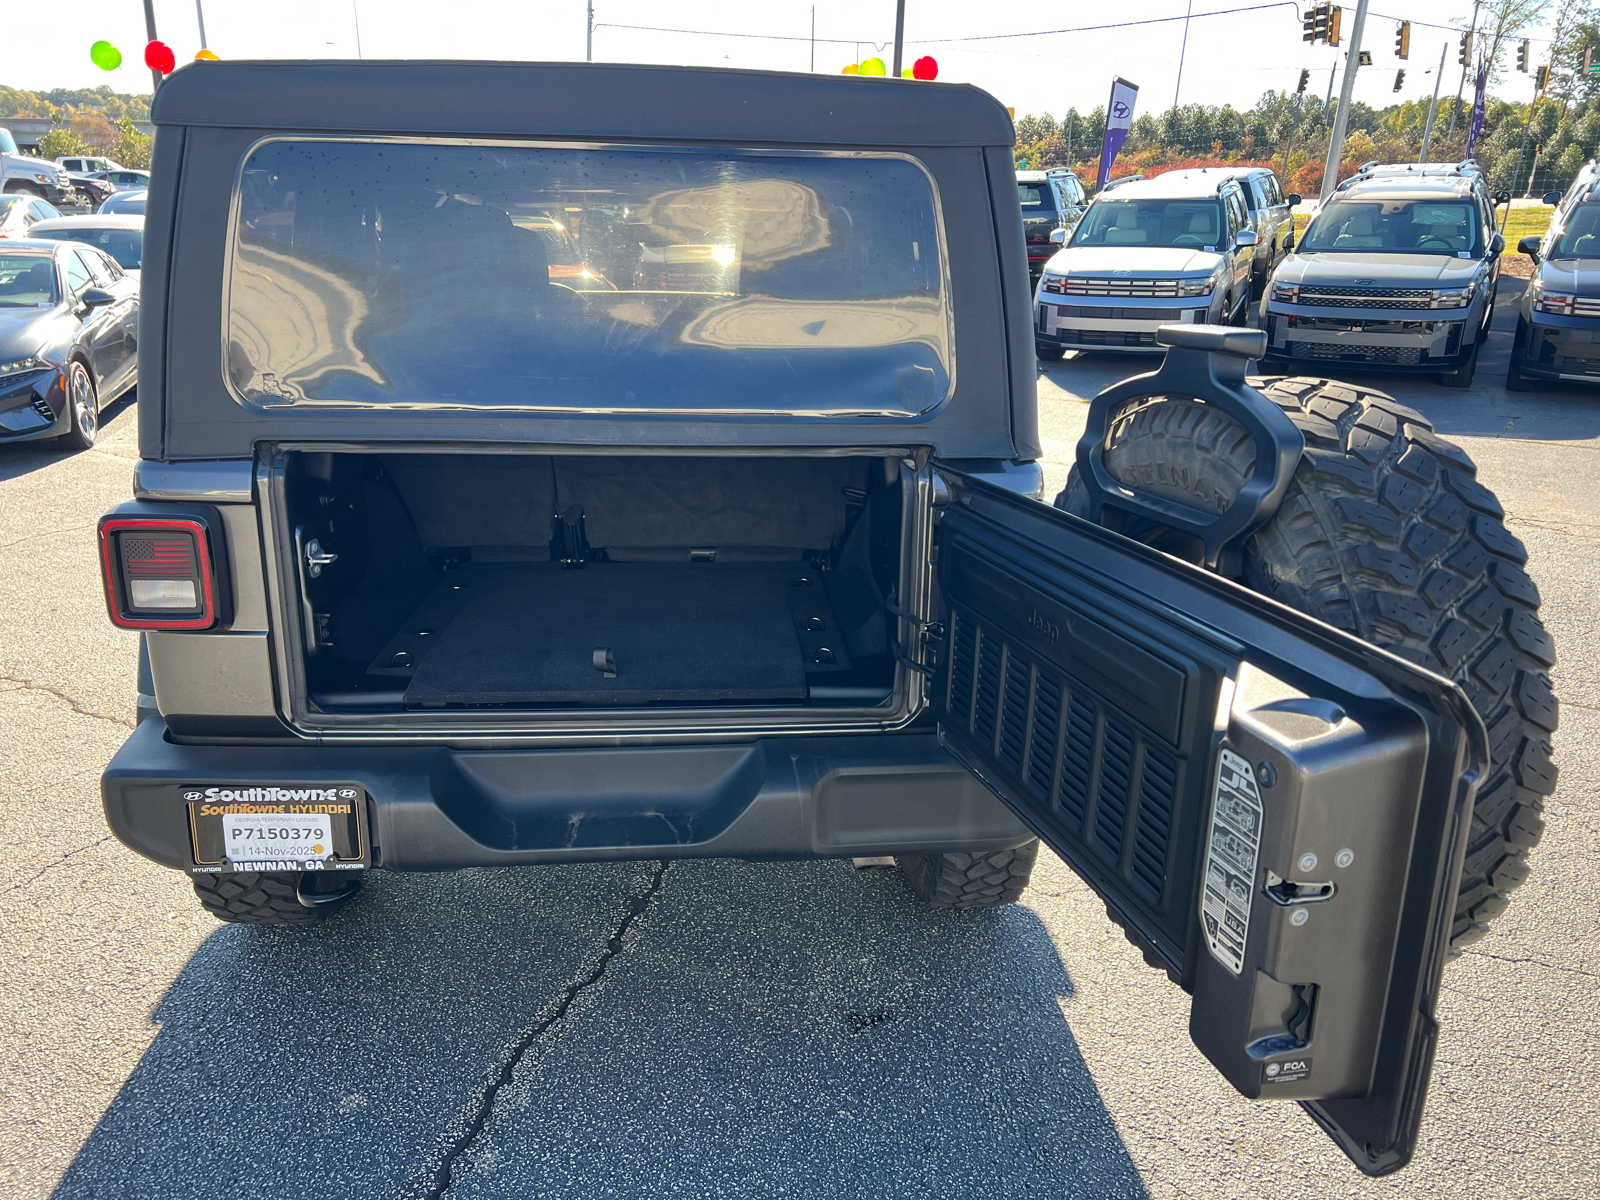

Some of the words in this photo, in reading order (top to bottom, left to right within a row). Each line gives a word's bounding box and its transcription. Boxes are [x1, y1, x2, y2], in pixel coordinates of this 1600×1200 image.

[1028, 608, 1059, 645] Jeep
[1229, 756, 1244, 771] Jeep
[1220, 772, 1257, 799] JL
[290, 804, 351, 814] HYUNDAI
[231, 828, 324, 840] P7150379
[248, 846, 317, 856] 14-Nov-2025
[233, 860, 301, 872] NEWNAN,
[305, 860, 325, 870] GA
[1225, 915, 1244, 937] USA
[1283, 1060, 1306, 1071] FCA
